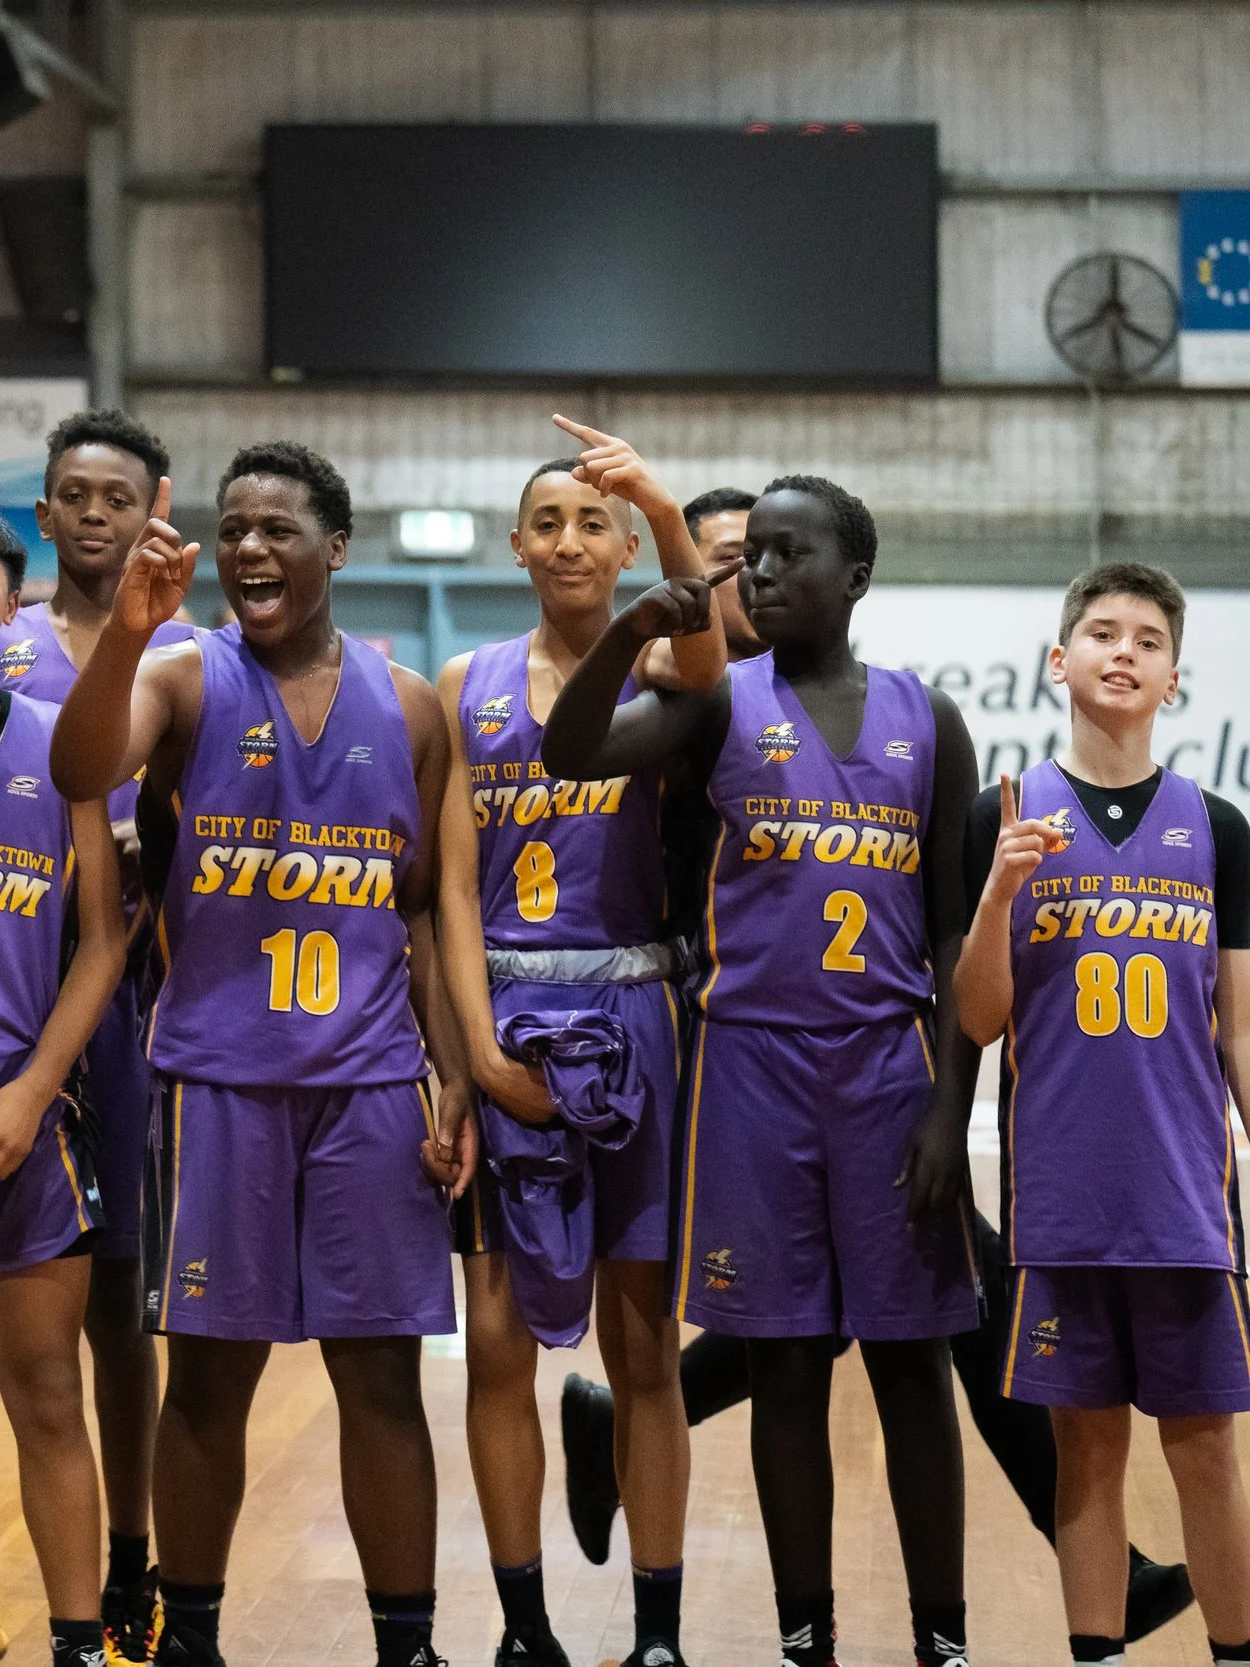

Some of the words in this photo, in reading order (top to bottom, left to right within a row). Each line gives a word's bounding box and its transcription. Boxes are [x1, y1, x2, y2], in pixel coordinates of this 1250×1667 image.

[503, 762, 522, 780] OF
[195, 815, 245, 838] CITY
[252, 818, 281, 840] OF
[473, 776, 632, 829] STORM
[746, 798, 792, 816] CITY
[798, 799, 824, 817] OF
[742, 820, 921, 875] STORM
[191, 845, 396, 910] STORM
[513, 841, 559, 923] 8
[1031, 877, 1073, 898] CITY
[1079, 875, 1105, 893] OF
[821, 889, 868, 973] 2
[1029, 898, 1213, 947] STORM
[260, 928, 340, 1016] 10
[1075, 952, 1169, 1038] 80
